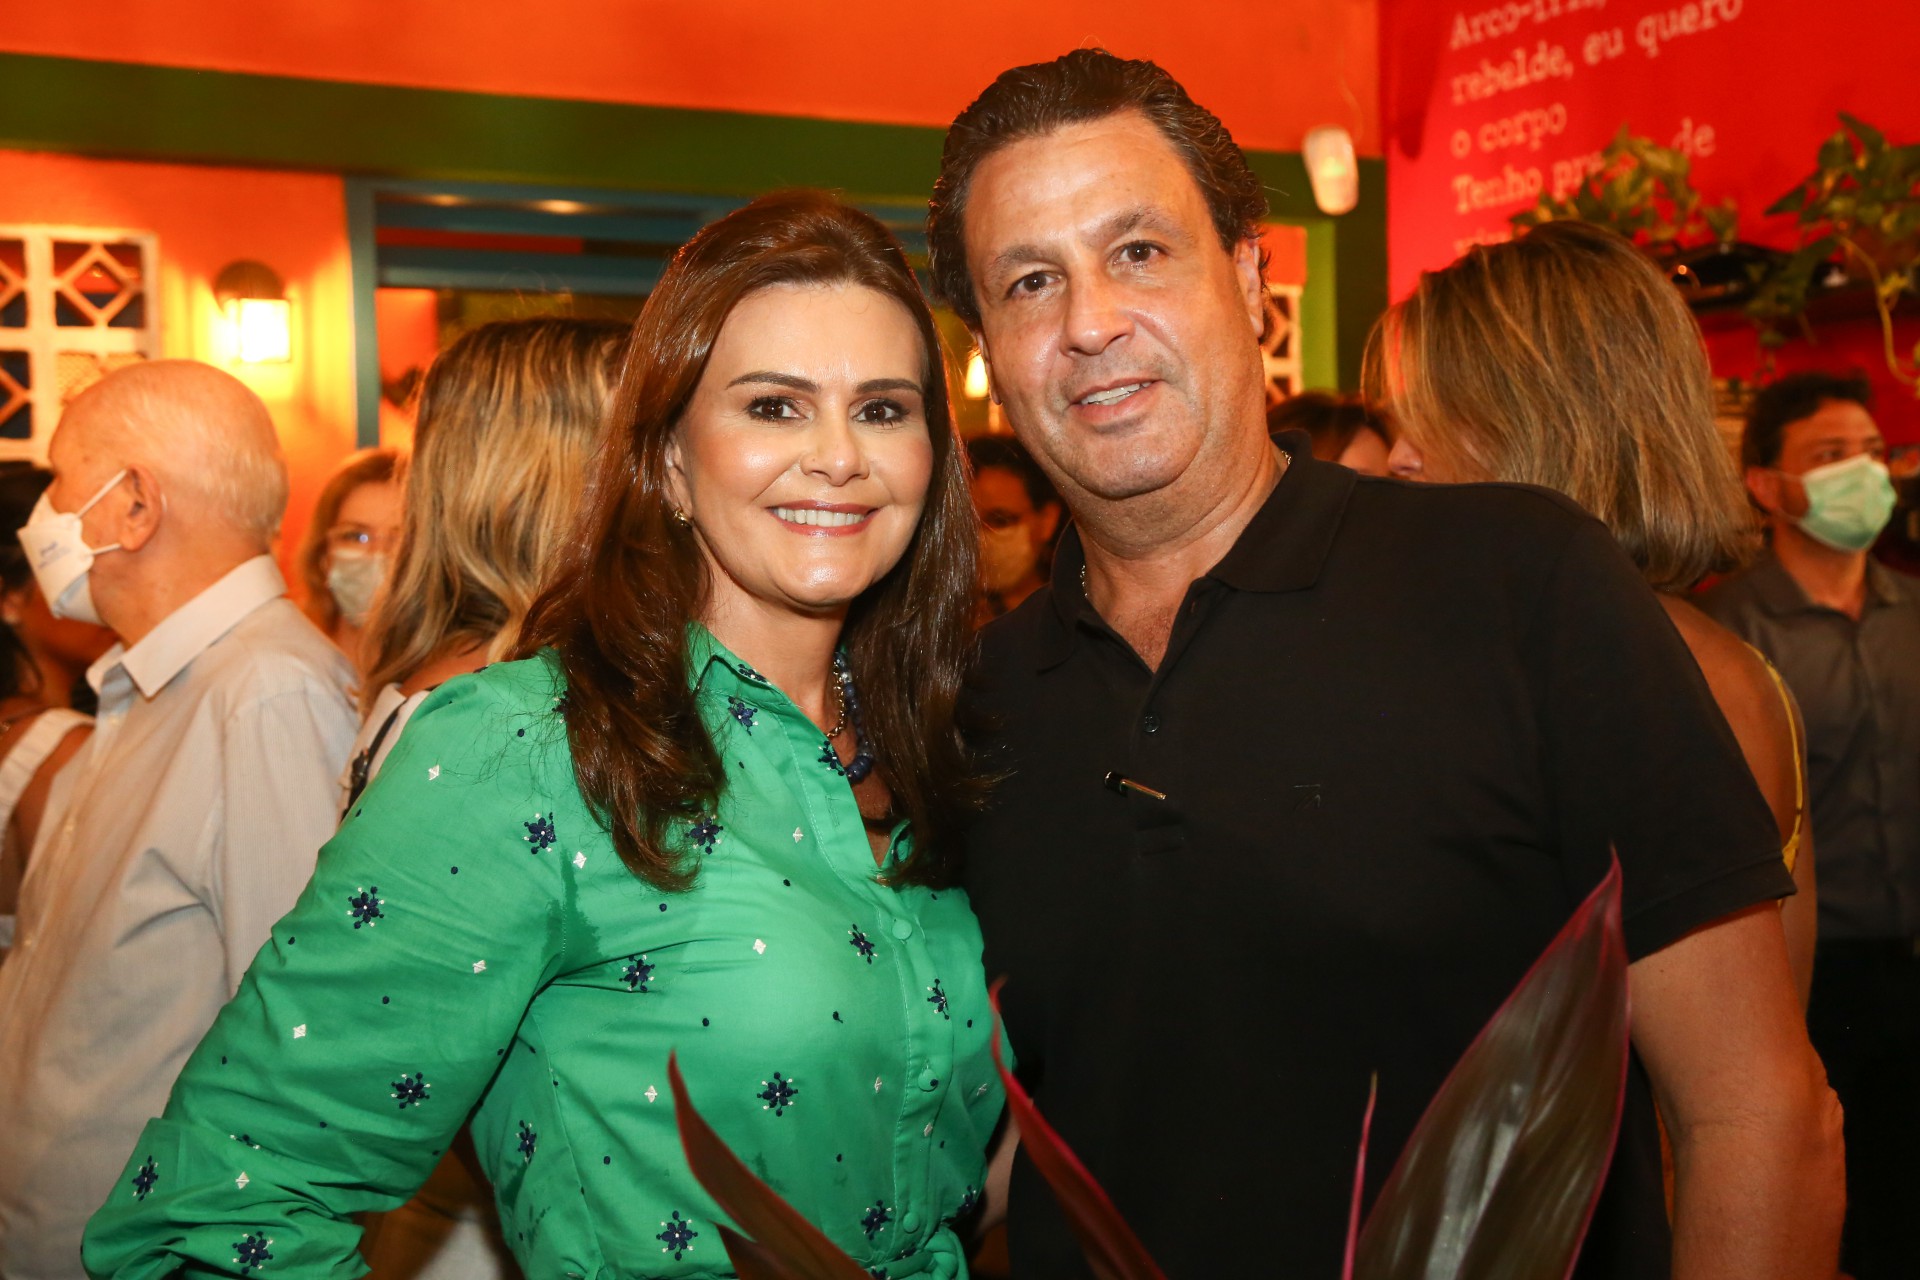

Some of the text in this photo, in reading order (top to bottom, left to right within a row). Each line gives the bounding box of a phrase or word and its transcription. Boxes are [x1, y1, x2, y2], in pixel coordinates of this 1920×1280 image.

[1452, 0, 1743, 103] rebelde, eu quero
[1452, 102, 1567, 158] o corpo
[1452, 163, 1543, 214] Tenho
[1671, 117, 1716, 157] de
